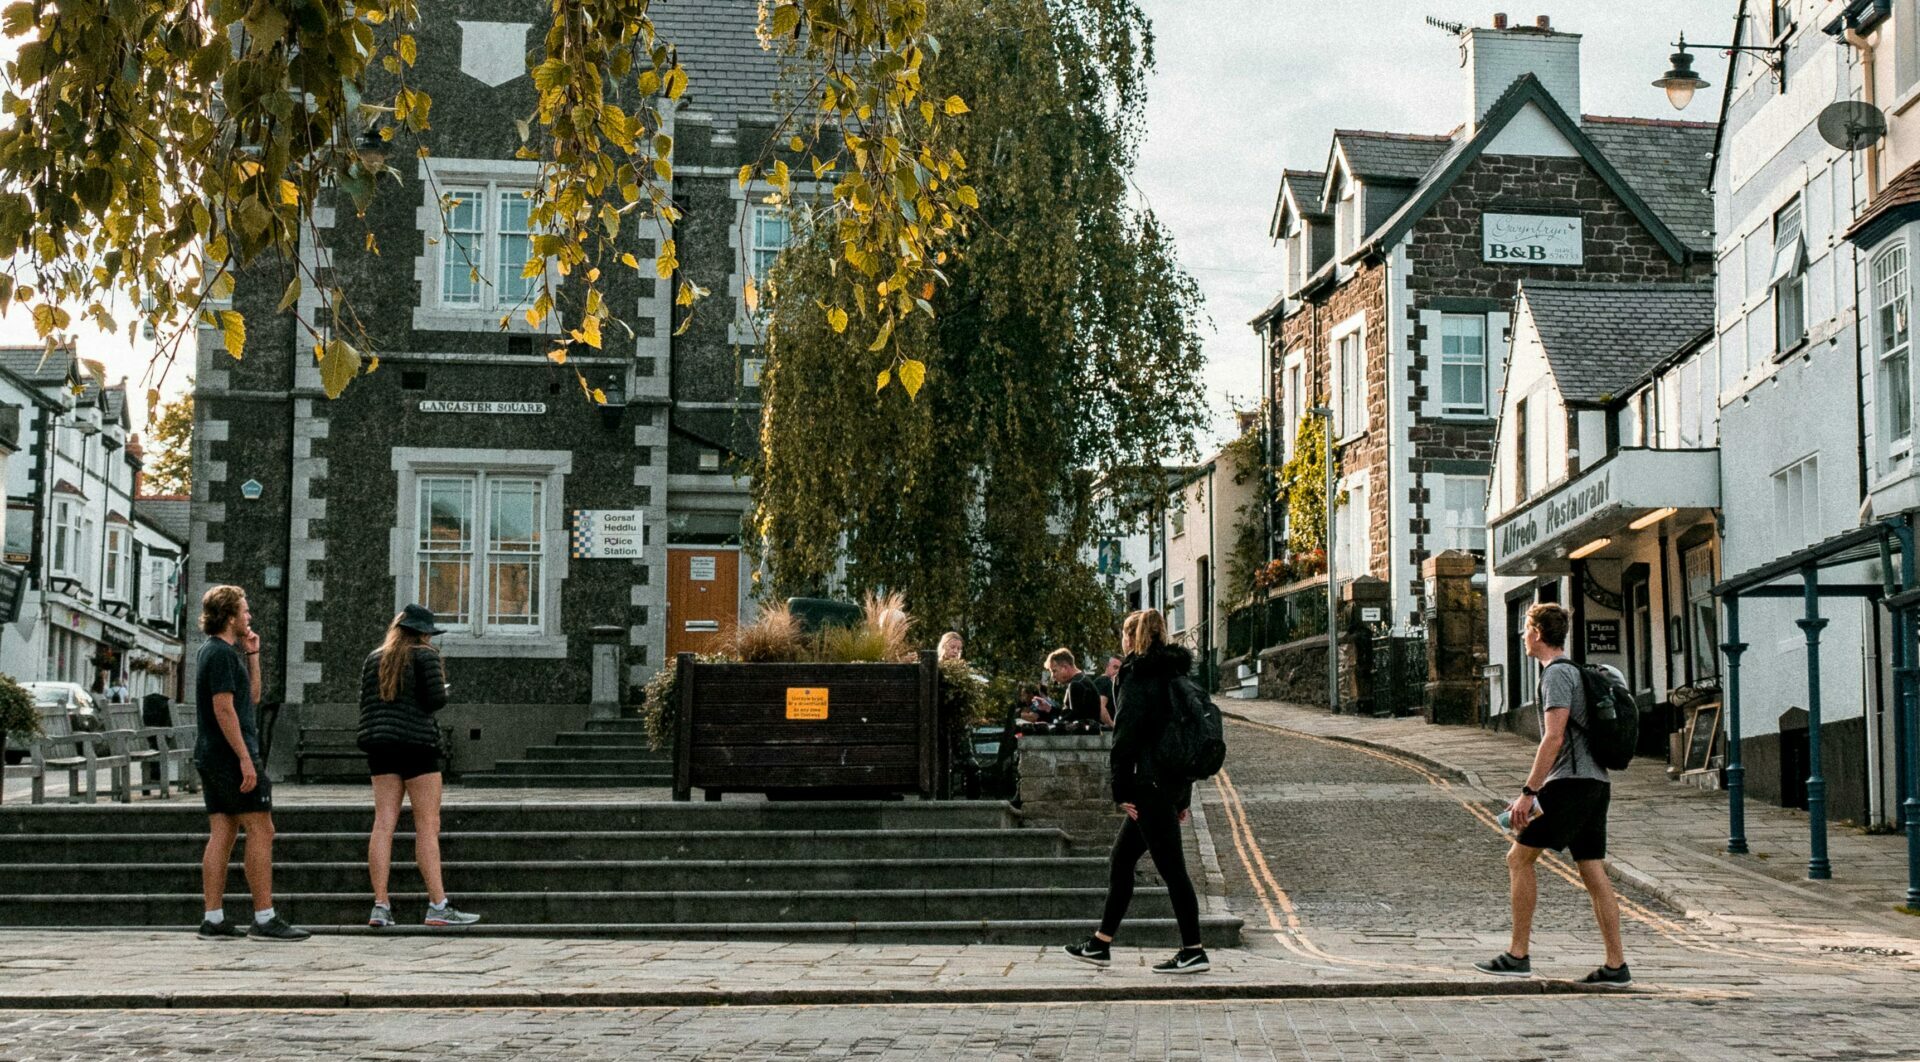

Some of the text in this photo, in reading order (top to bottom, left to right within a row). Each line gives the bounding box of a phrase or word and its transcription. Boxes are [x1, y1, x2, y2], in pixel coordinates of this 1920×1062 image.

[1488, 243, 1546, 260] B&B
[422, 401, 543, 413] LANCASTER SQUARE
[1502, 469, 1610, 557] Alfredo Restaurant
[604, 514, 635, 522] Gorsaf
[604, 524, 637, 532] Heddlu
[604, 537, 633, 545] Police
[604, 547, 637, 555] Station
[1590, 623, 1615, 631] Pizza
[1599, 633, 1607, 641] &
[1590, 643, 1617, 651] Pasta
